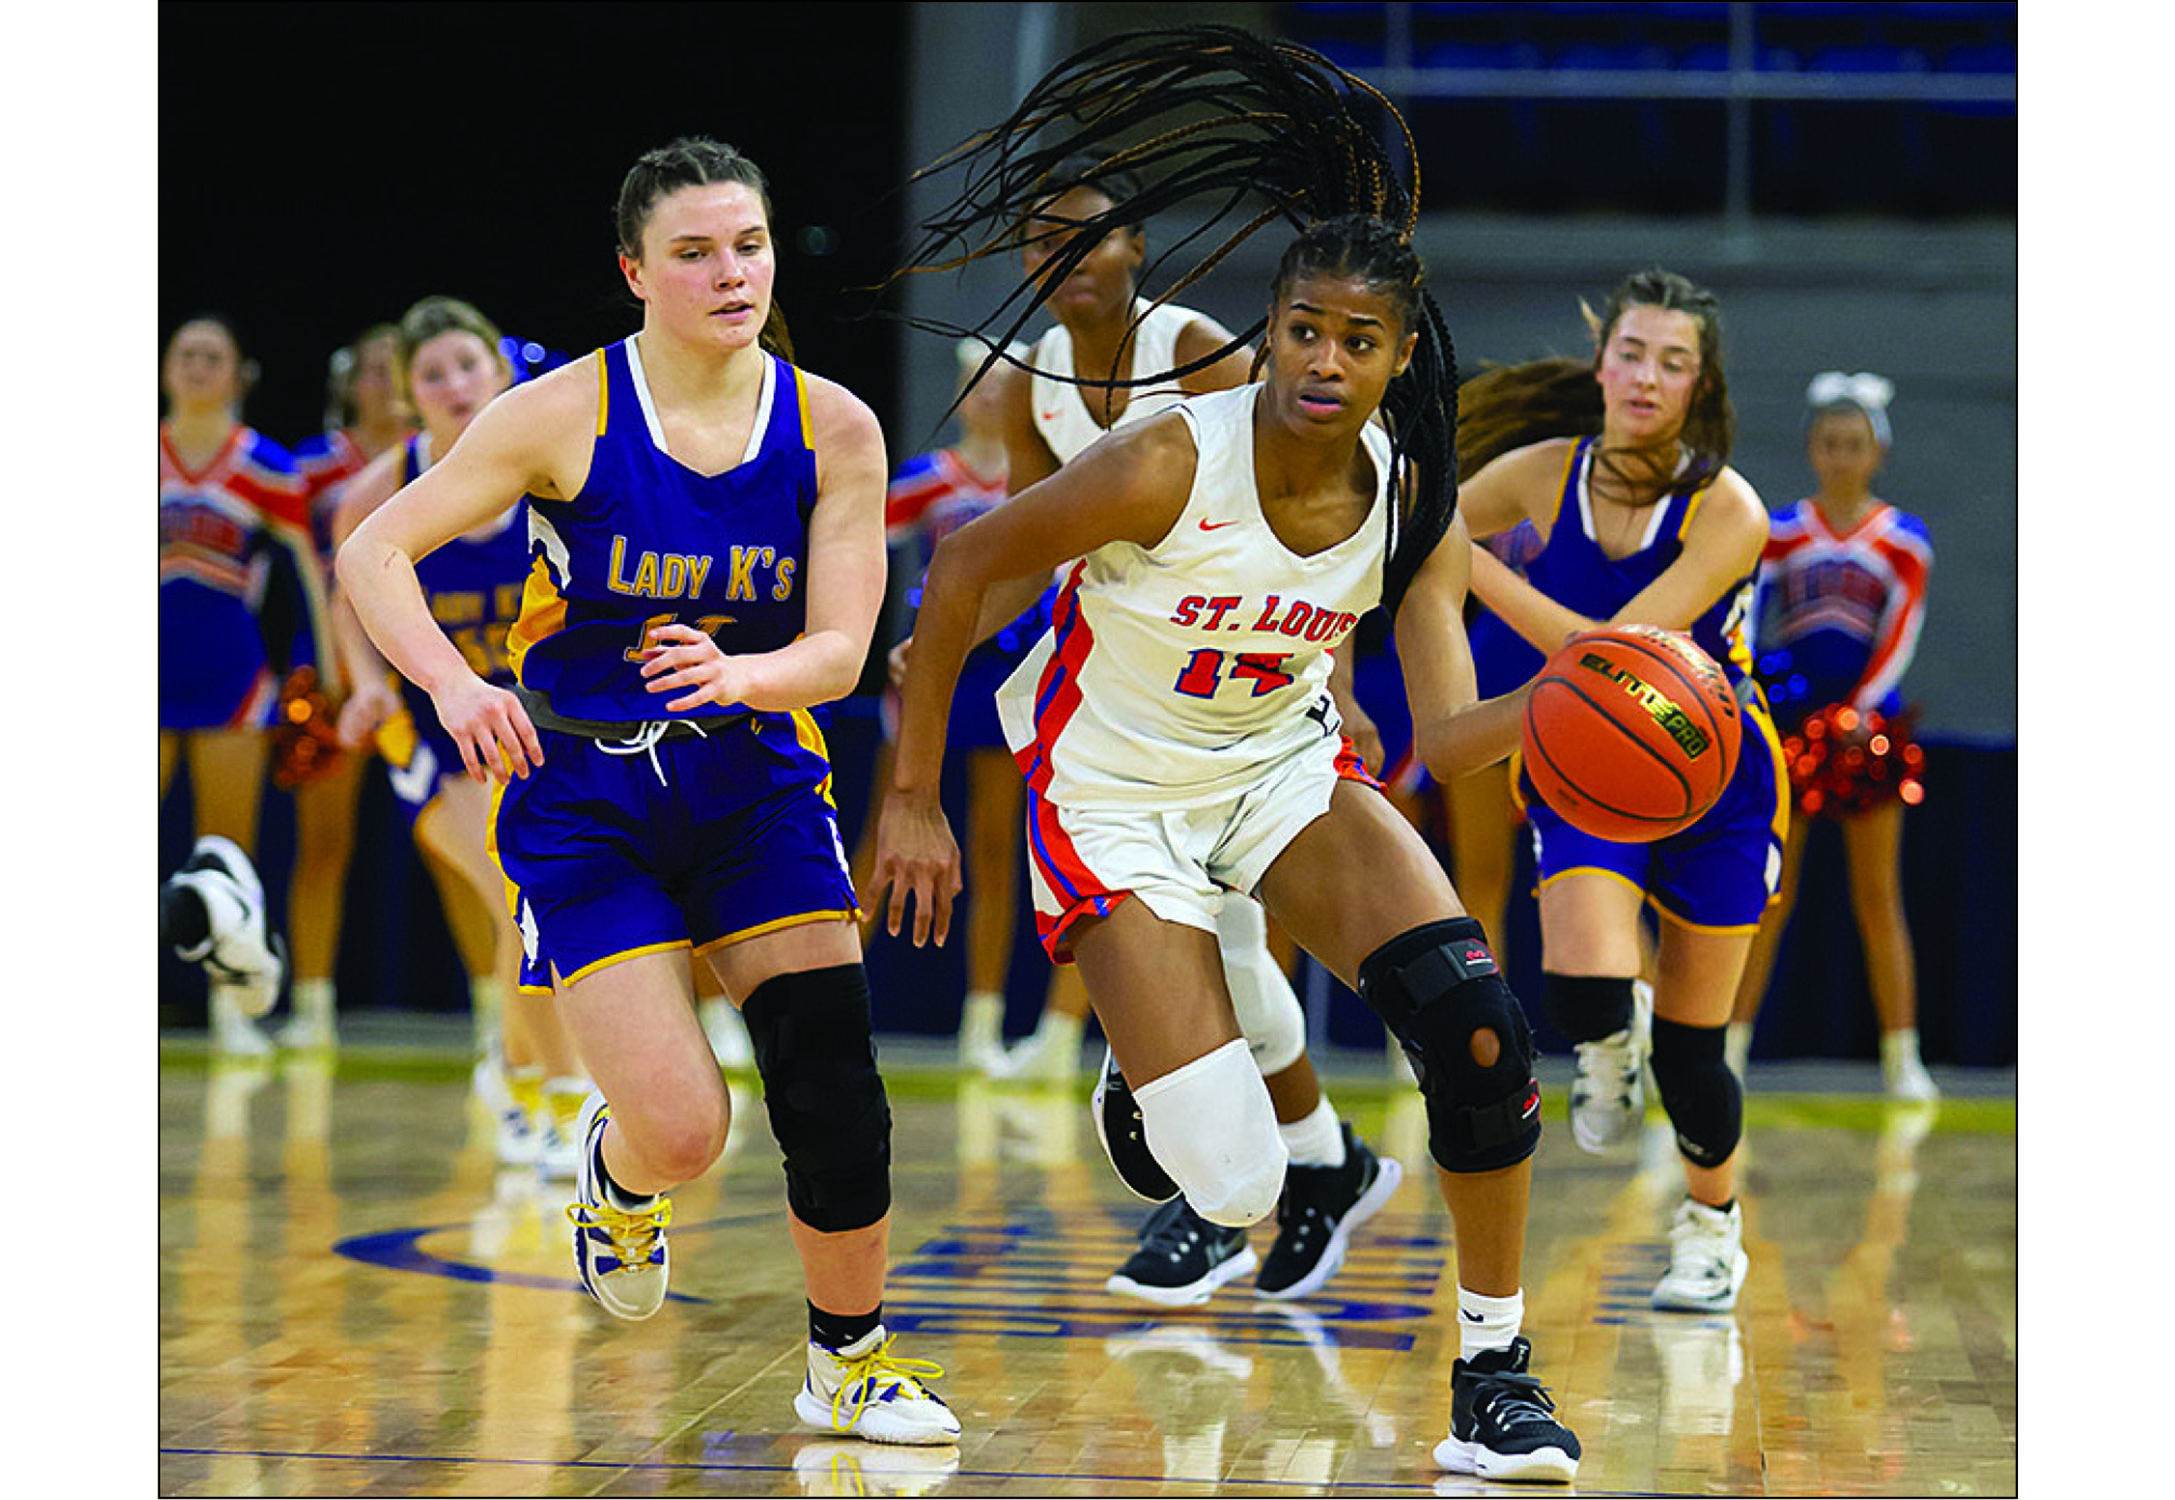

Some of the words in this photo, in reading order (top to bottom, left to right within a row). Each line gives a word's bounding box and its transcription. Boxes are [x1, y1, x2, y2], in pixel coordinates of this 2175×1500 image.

[607, 535, 712, 599] LADY
[1170, 595, 1242, 631] ST.
[1580, 653, 1677, 722] ELITE
[1666, 708, 1710, 762] PRO
